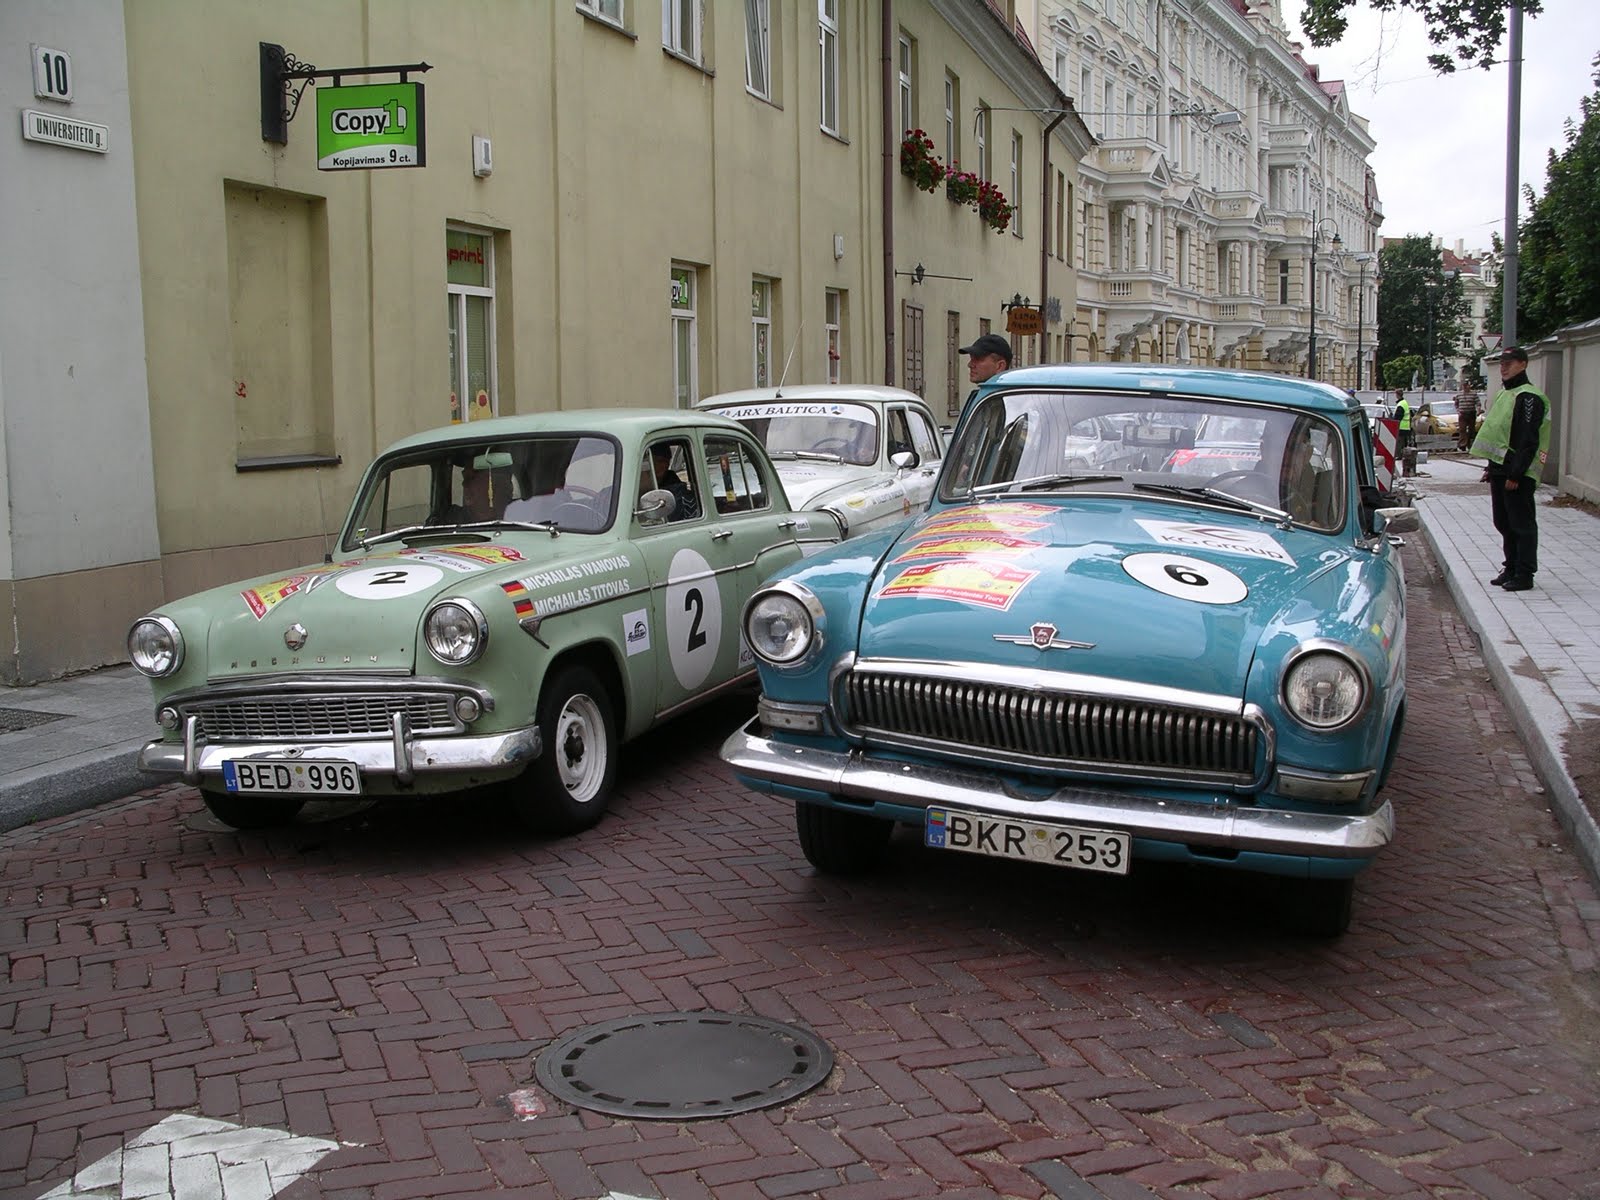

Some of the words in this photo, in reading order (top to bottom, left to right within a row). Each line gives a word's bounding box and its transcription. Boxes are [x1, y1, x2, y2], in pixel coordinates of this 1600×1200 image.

[43, 52, 68, 96] 10
[36, 117, 94, 144] UNIVERSITETO
[95, 132, 104, 148] g.
[332, 156, 386, 169] Kopijavimas
[389, 148, 397, 163] 9
[398, 154, 411, 163] ct.
[731, 407, 762, 418] ARX
[764, 405, 828, 415] BALTICA
[1161, 535, 1197, 545] KG
[1202, 540, 1284, 560] Group
[366, 571, 409, 585] 2
[519, 565, 581, 592] MICHAILAS
[580, 554, 630, 577] IVANOVAS
[1163, 564, 1209, 587] 6
[534, 587, 592, 616] MICHAILAS
[590, 578, 630, 600] TITOVAS
[685, 587, 707, 654] 2
[226, 778, 237, 788] LT
[238, 764, 292, 790] BED
[307, 765, 355, 791] 996
[929, 833, 944, 845] LT
[950, 815, 1027, 857] BKR
[1054, 831, 1122, 869] 253
